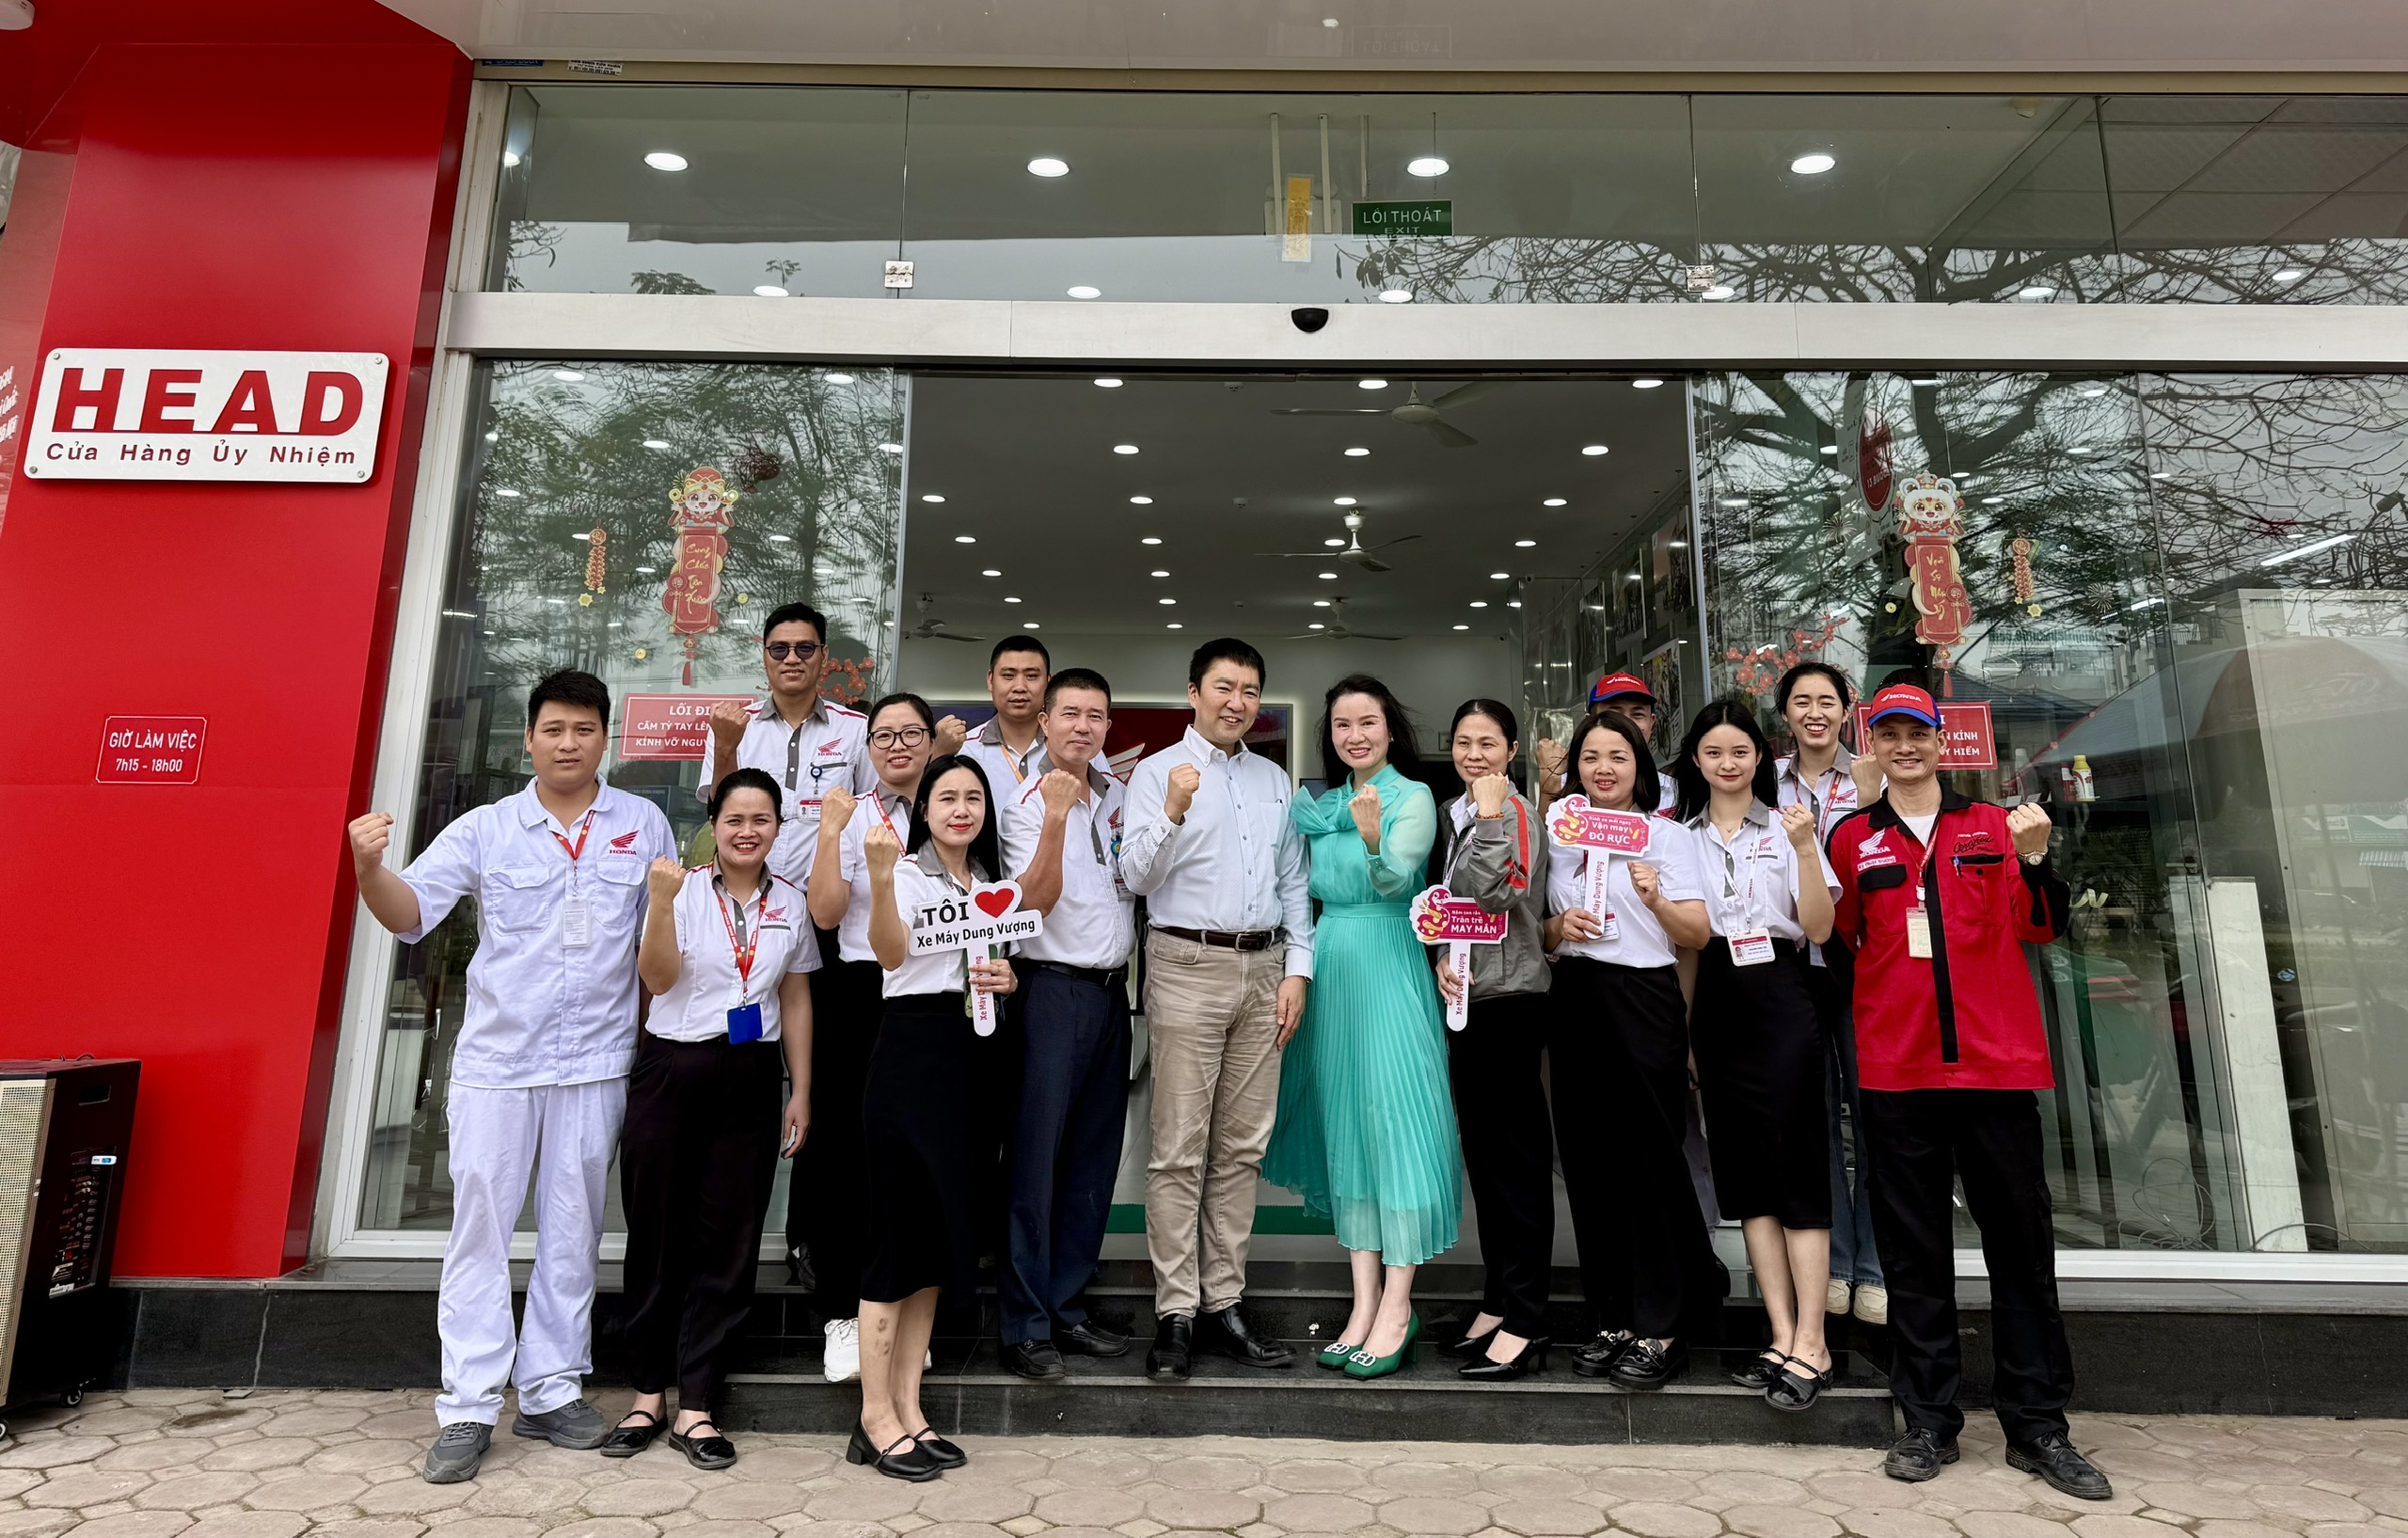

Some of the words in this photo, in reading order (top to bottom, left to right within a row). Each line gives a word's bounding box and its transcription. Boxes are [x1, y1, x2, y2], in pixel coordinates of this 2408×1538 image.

[1390, 206, 1442, 223] THOÁT
[1384, 226, 1420, 234] EXIT
[52, 367, 364, 436] HEAD
[46, 440, 99, 461] Cửa
[119, 443, 192, 465] Hàng
[213, 438, 248, 466] Ủy
[269, 445, 356, 468] Nhiệm
[686, 543, 712, 559] Cung
[1888, 693, 1923, 703] HONDA
[670, 702, 691, 716] LỐI
[694, 706, 711, 716] ĐI
[637, 720, 657, 731] CẤM
[673, 722, 693, 731] TAY
[109, 729, 134, 749] GIỜ
[135, 728, 164, 749] LÀM
[167, 729, 198, 753] VIỆC
[1953, 729, 1978, 740] KÍNH
[636, 736, 661, 747] KÍNH
[664, 737, 680, 747] VỠ
[116, 757, 139, 771] 7h15
[151, 758, 183, 772] 18h00
[1592, 821, 1608, 831] Vận
[1609, 824, 1629, 834] may
[1588, 831, 1605, 842] ĐỎ
[1607, 833, 1630, 846] RỰC
[922, 898, 970, 927] TÔI
[1451, 915, 1470, 924] Tràn
[916, 935, 933, 948] Xe
[935, 929, 960, 945] Máy
[962, 927, 994, 941] Dung
[996, 920, 1035, 936] Vượng
[1450, 924, 1473, 933] MAY
[1474, 923, 1497, 934] MẮN
[979, 1010, 988, 1021] Xe
[1455, 1007, 1464, 1016] Xe
